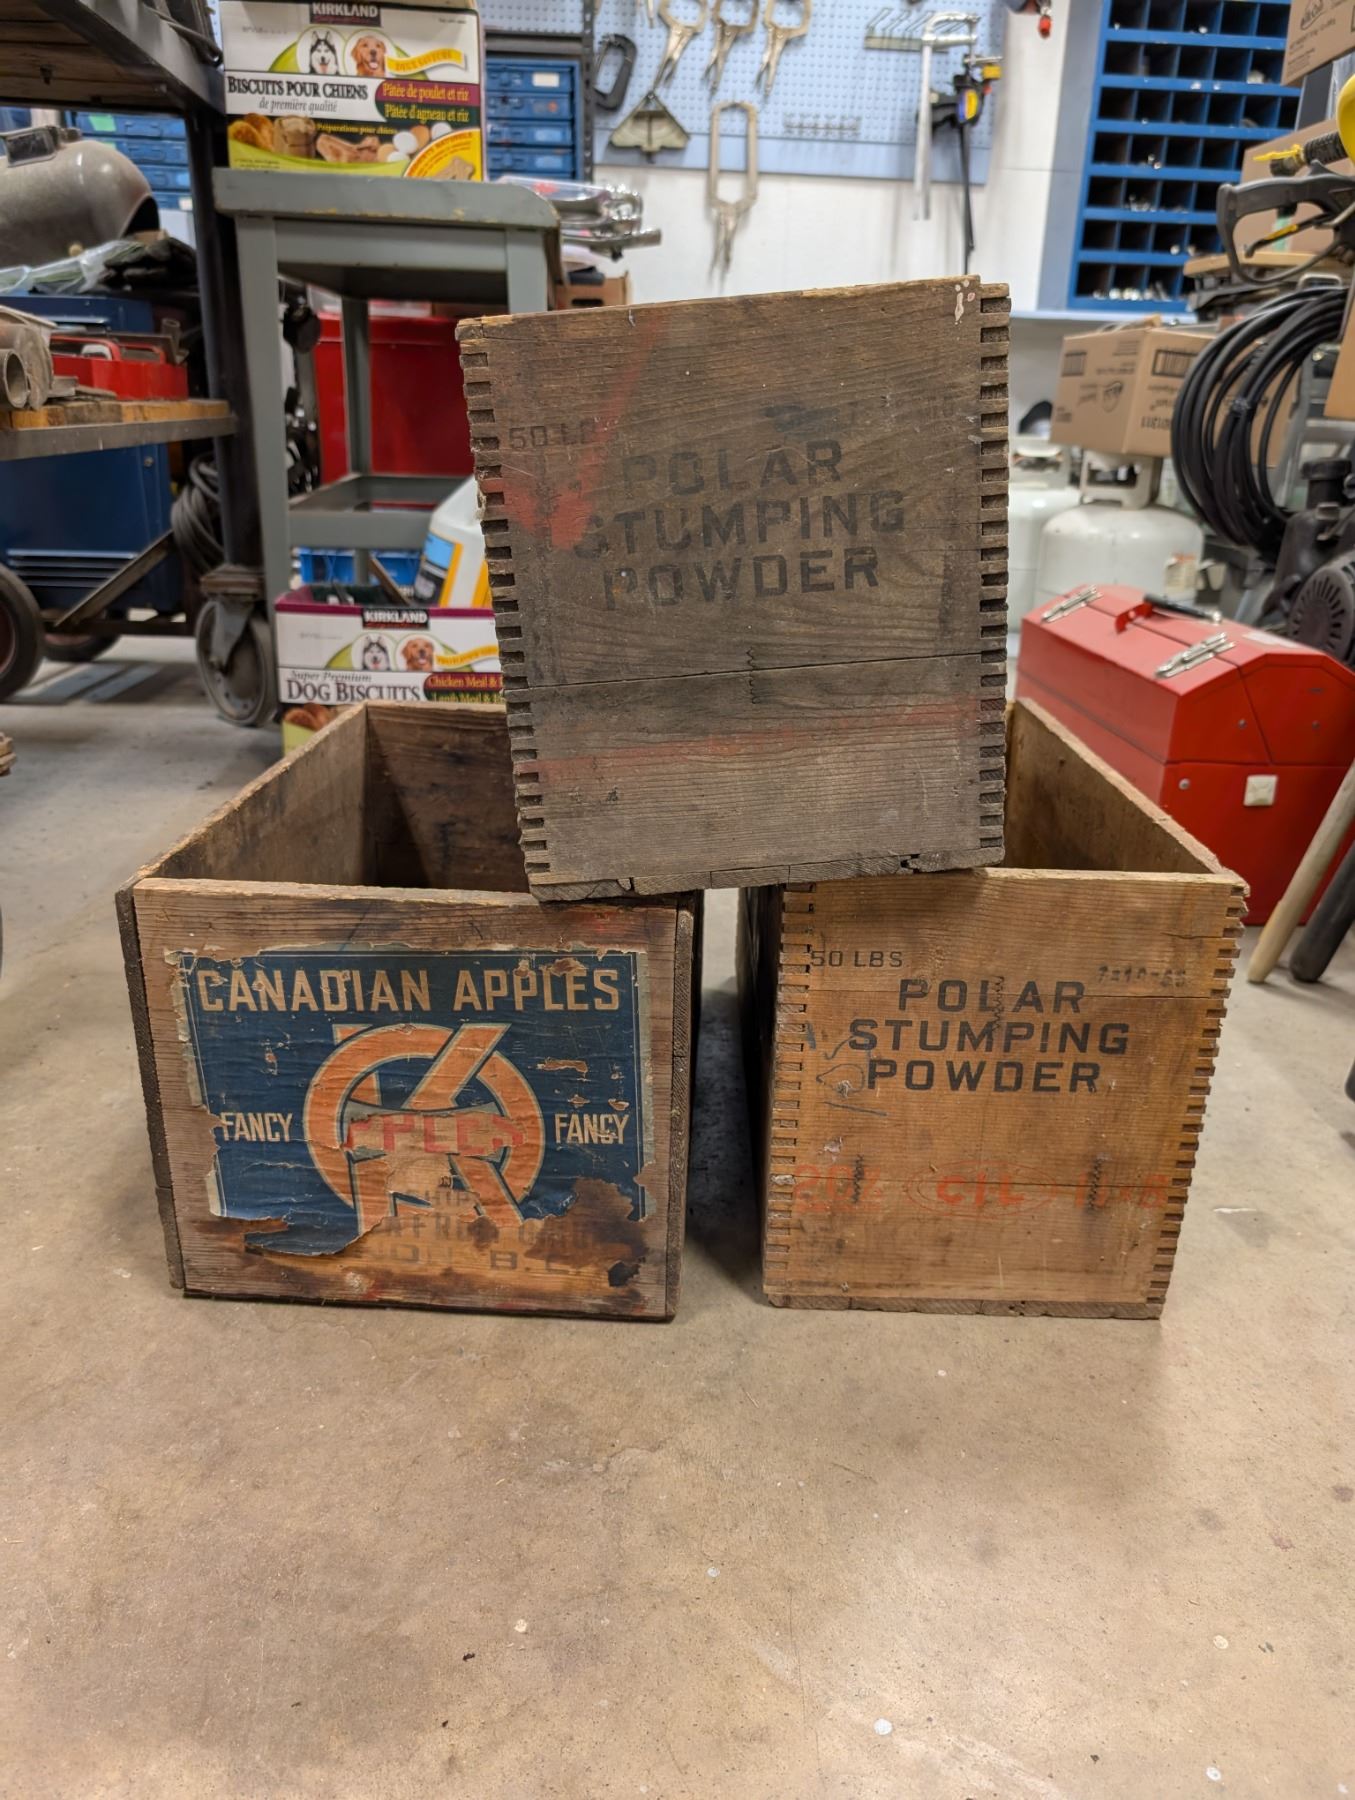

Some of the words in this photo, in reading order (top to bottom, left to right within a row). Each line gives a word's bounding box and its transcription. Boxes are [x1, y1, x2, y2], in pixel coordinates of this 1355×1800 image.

[312, 3, 378, 18] KIRKLAND
[227, 76, 284, 97] BISCUITS
[286, 81, 321, 97] POUR
[322, 83, 368, 100] CHIENS
[406, 83, 417, 98] de
[419, 85, 446, 103] poulet
[447, 88, 456, 100] et
[457, 88, 470, 101] riz
[259, 97, 269, 109] de
[447, 110, 456, 121] et
[457, 108, 470, 122] riz
[508, 426, 548, 449] 50
[621, 439, 843, 497] POLAR
[574, 489, 905, 560] STUMPING
[604, 546, 880, 611] POWDER
[363, 610, 429, 624] KIRKLAND
[290, 670, 320, 682] Super
[323, 671, 372, 683] Premium
[428, 674, 464, 688] Chicken
[465, 674, 487, 688] Meal
[287, 679, 331, 700] DOG
[336, 681, 421, 701] BISCUITS
[811, 951, 843, 968] 50
[854, 951, 904, 968] LBS
[196, 968, 431, 1013] CANADIAN
[453, 968, 620, 1013] APPLES
[899, 978, 1086, 1014] POLAR
[849, 1018, 1130, 1055] STUMPING
[867, 1060, 1101, 1094] POWDER
[221, 1111, 294, 1143] FANCY
[555, 1112, 628, 1145] FANCY
[936, 1172, 1026, 1208] CIL
